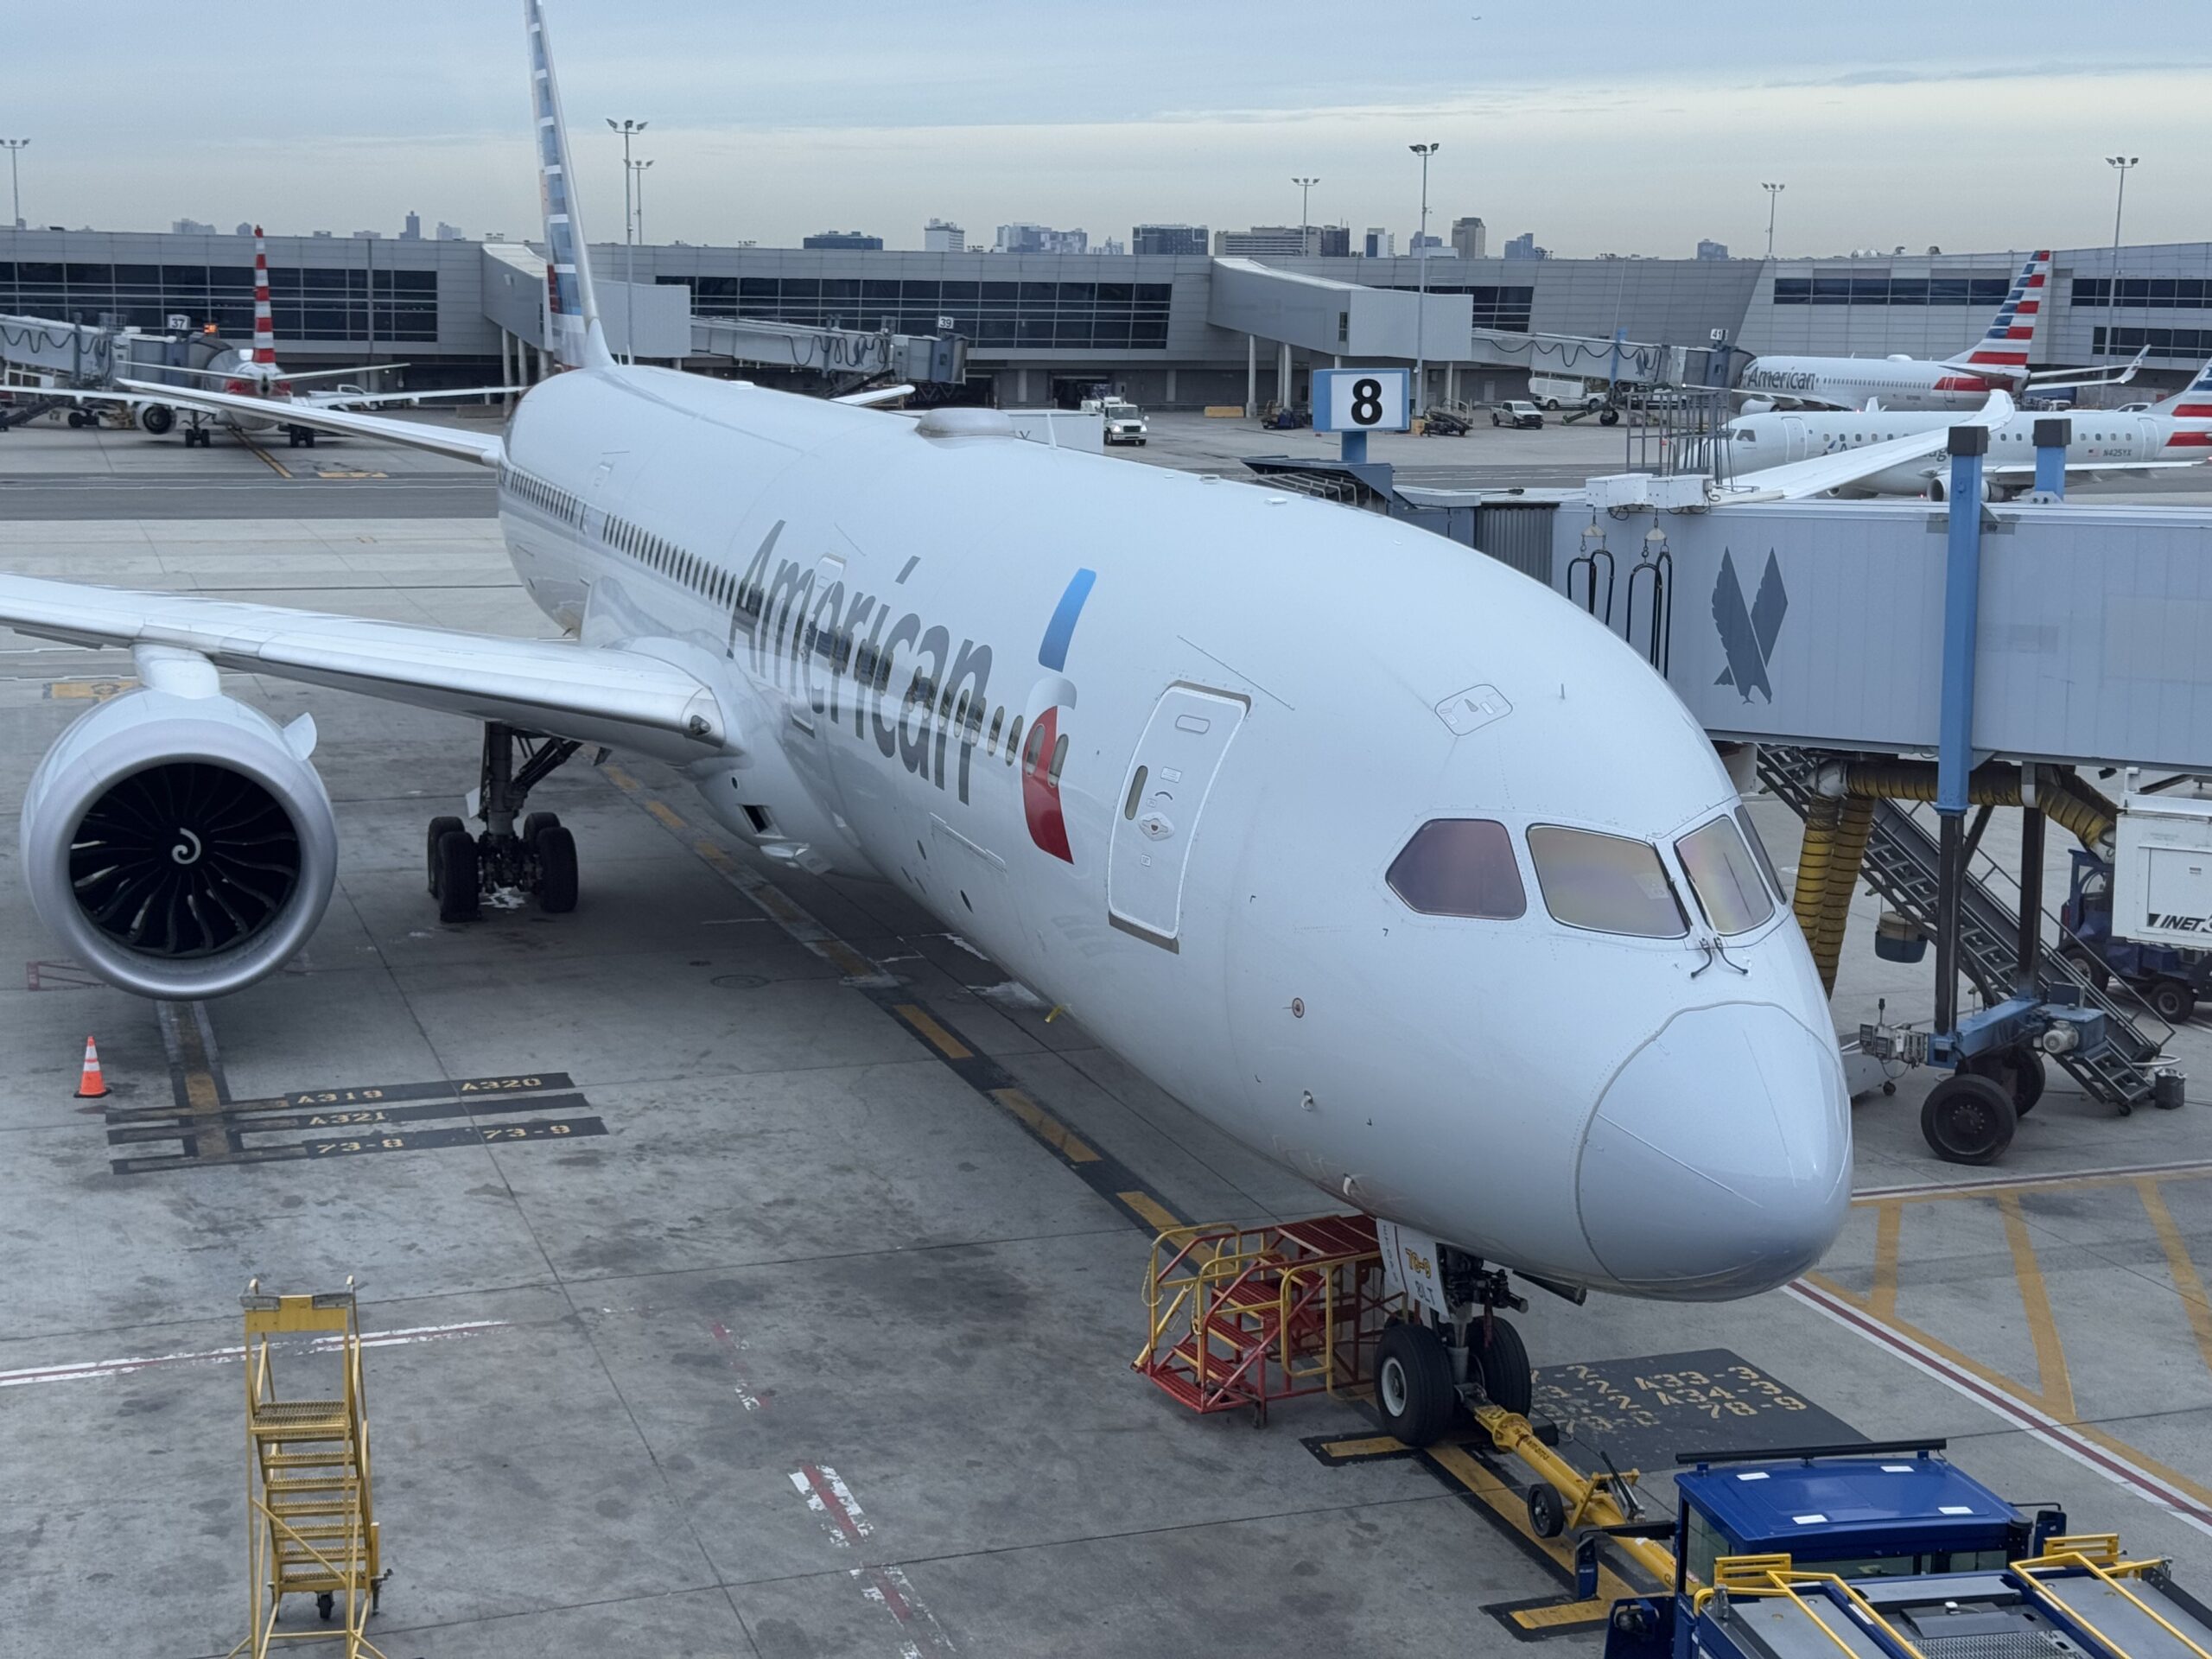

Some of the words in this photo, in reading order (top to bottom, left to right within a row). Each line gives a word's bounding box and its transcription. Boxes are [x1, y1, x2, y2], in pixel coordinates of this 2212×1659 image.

[171, 318, 185, 328] 37
[940, 318, 951, 328] 39
[1748, 366, 1815, 390] American
[1351, 378, 1382, 425] 8
[727, 519, 992, 806] American
[2160, 914, 2206, 931] INET
[461, 1077, 542, 1091] A320
[297, 1089, 384, 1104] A319
[309, 1110, 387, 1125] A321
[483, 1124, 571, 1140] 73-9
[316, 1138, 404, 1154] 73-8
[1635, 1366, 1759, 1389] A33-3
[1656, 1382, 1782, 1405] A34-3
[1698, 1396, 1807, 1418] 78-9
